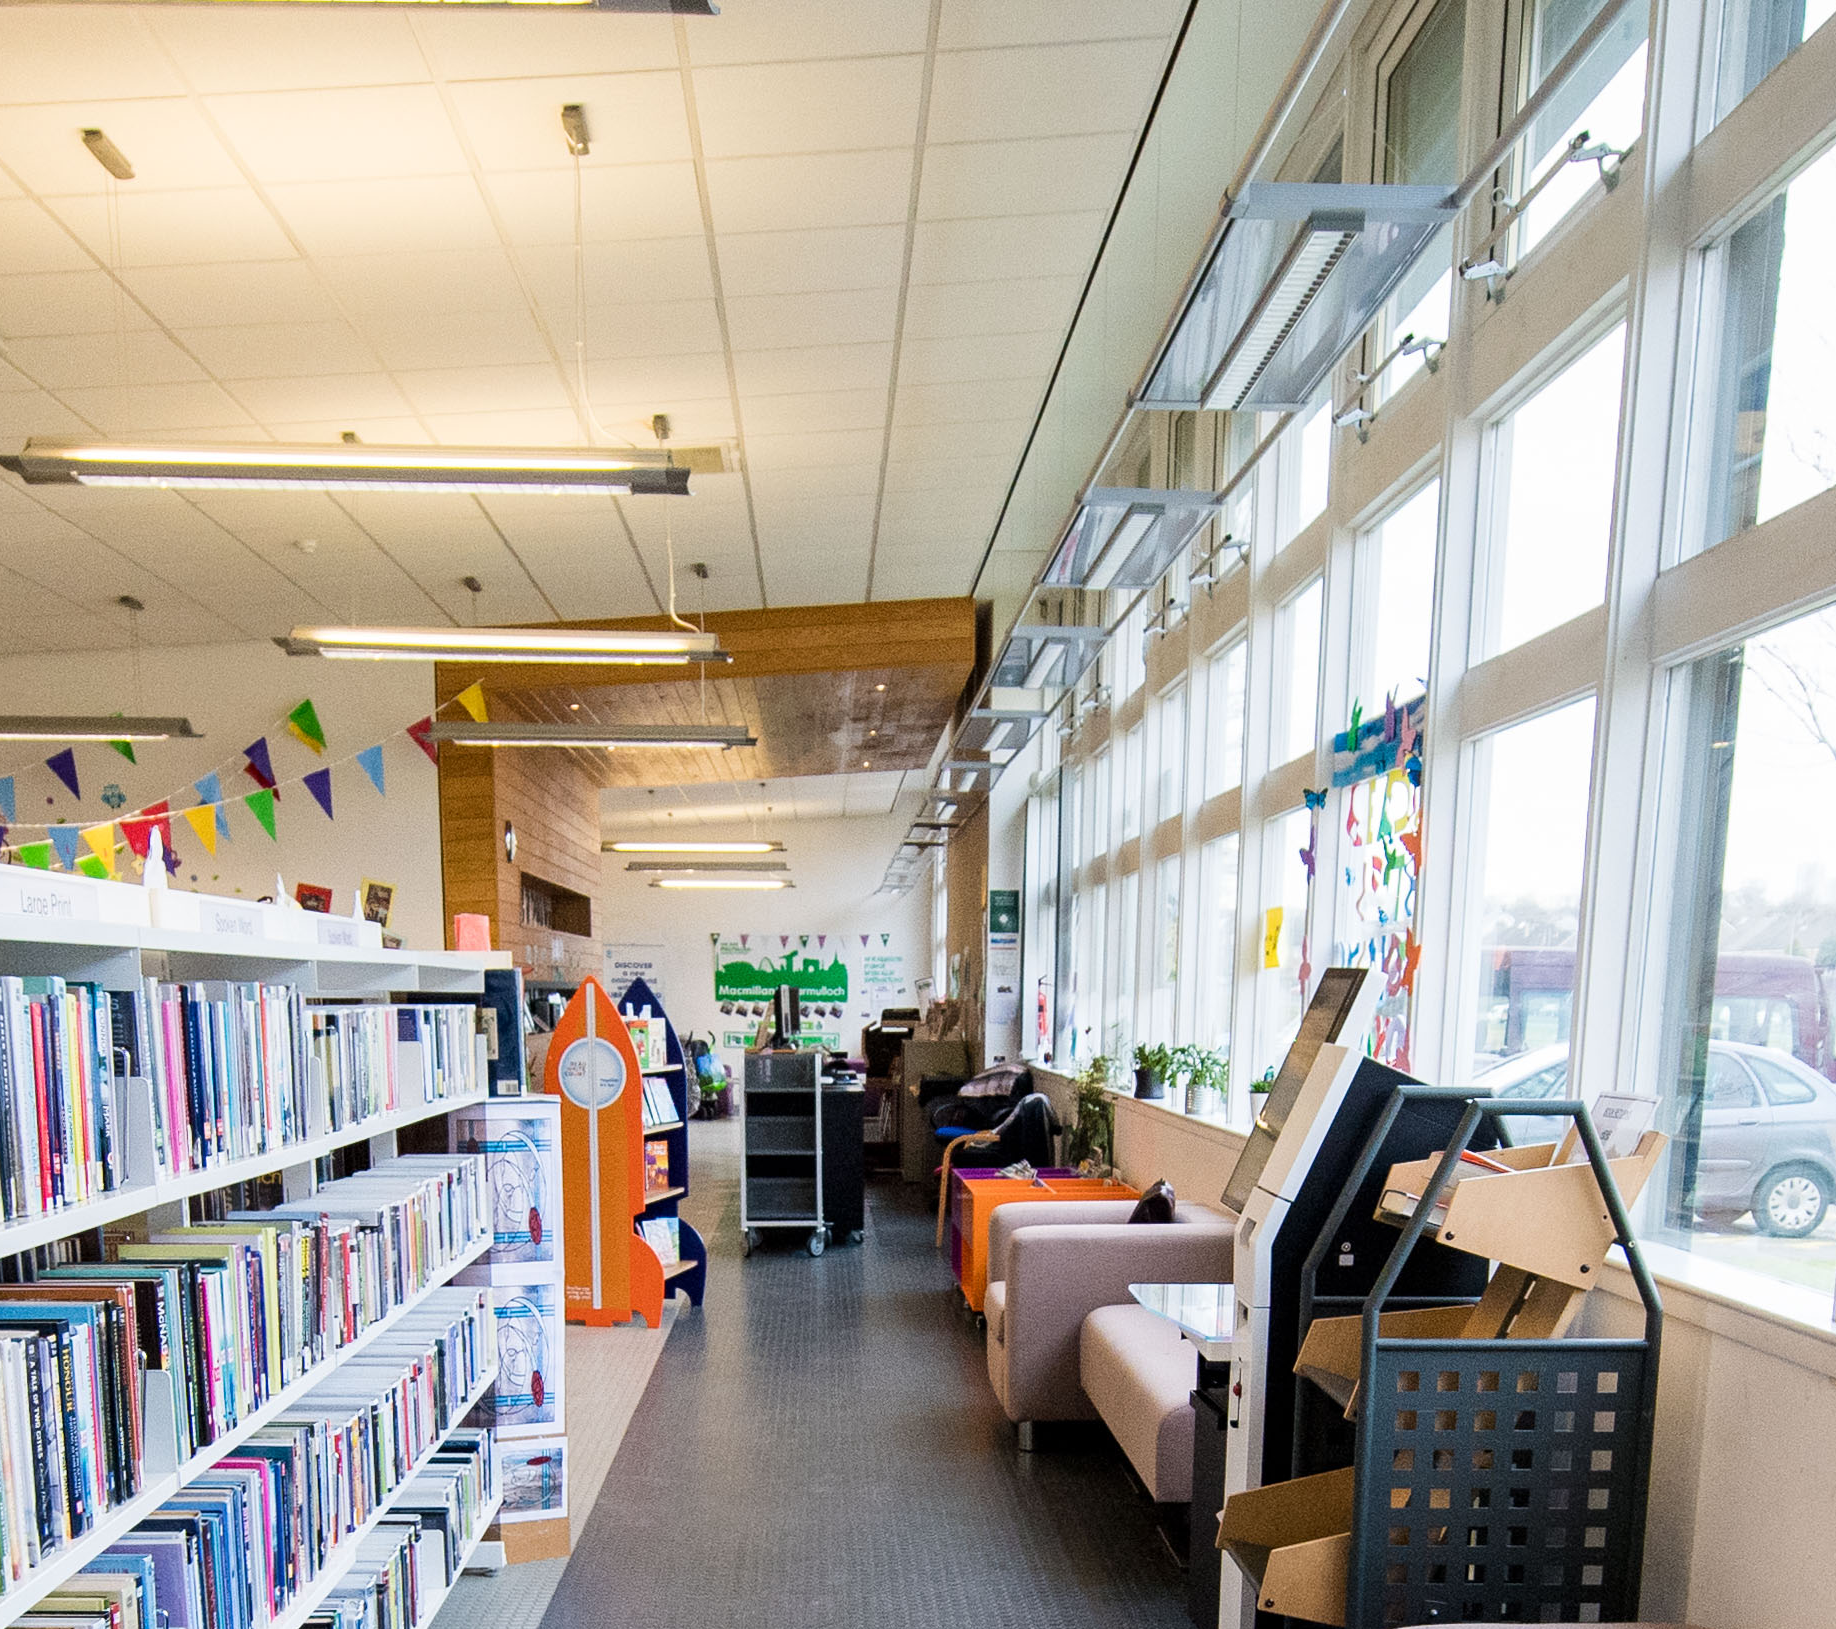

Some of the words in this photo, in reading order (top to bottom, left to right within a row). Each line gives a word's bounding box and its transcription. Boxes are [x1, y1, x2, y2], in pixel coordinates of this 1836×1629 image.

[20, 888, 48, 917] Large
[51, 890, 73, 916] Print
[62, 1347, 74, 1412] HONOUR
[32, 1394, 38, 1404] OF
